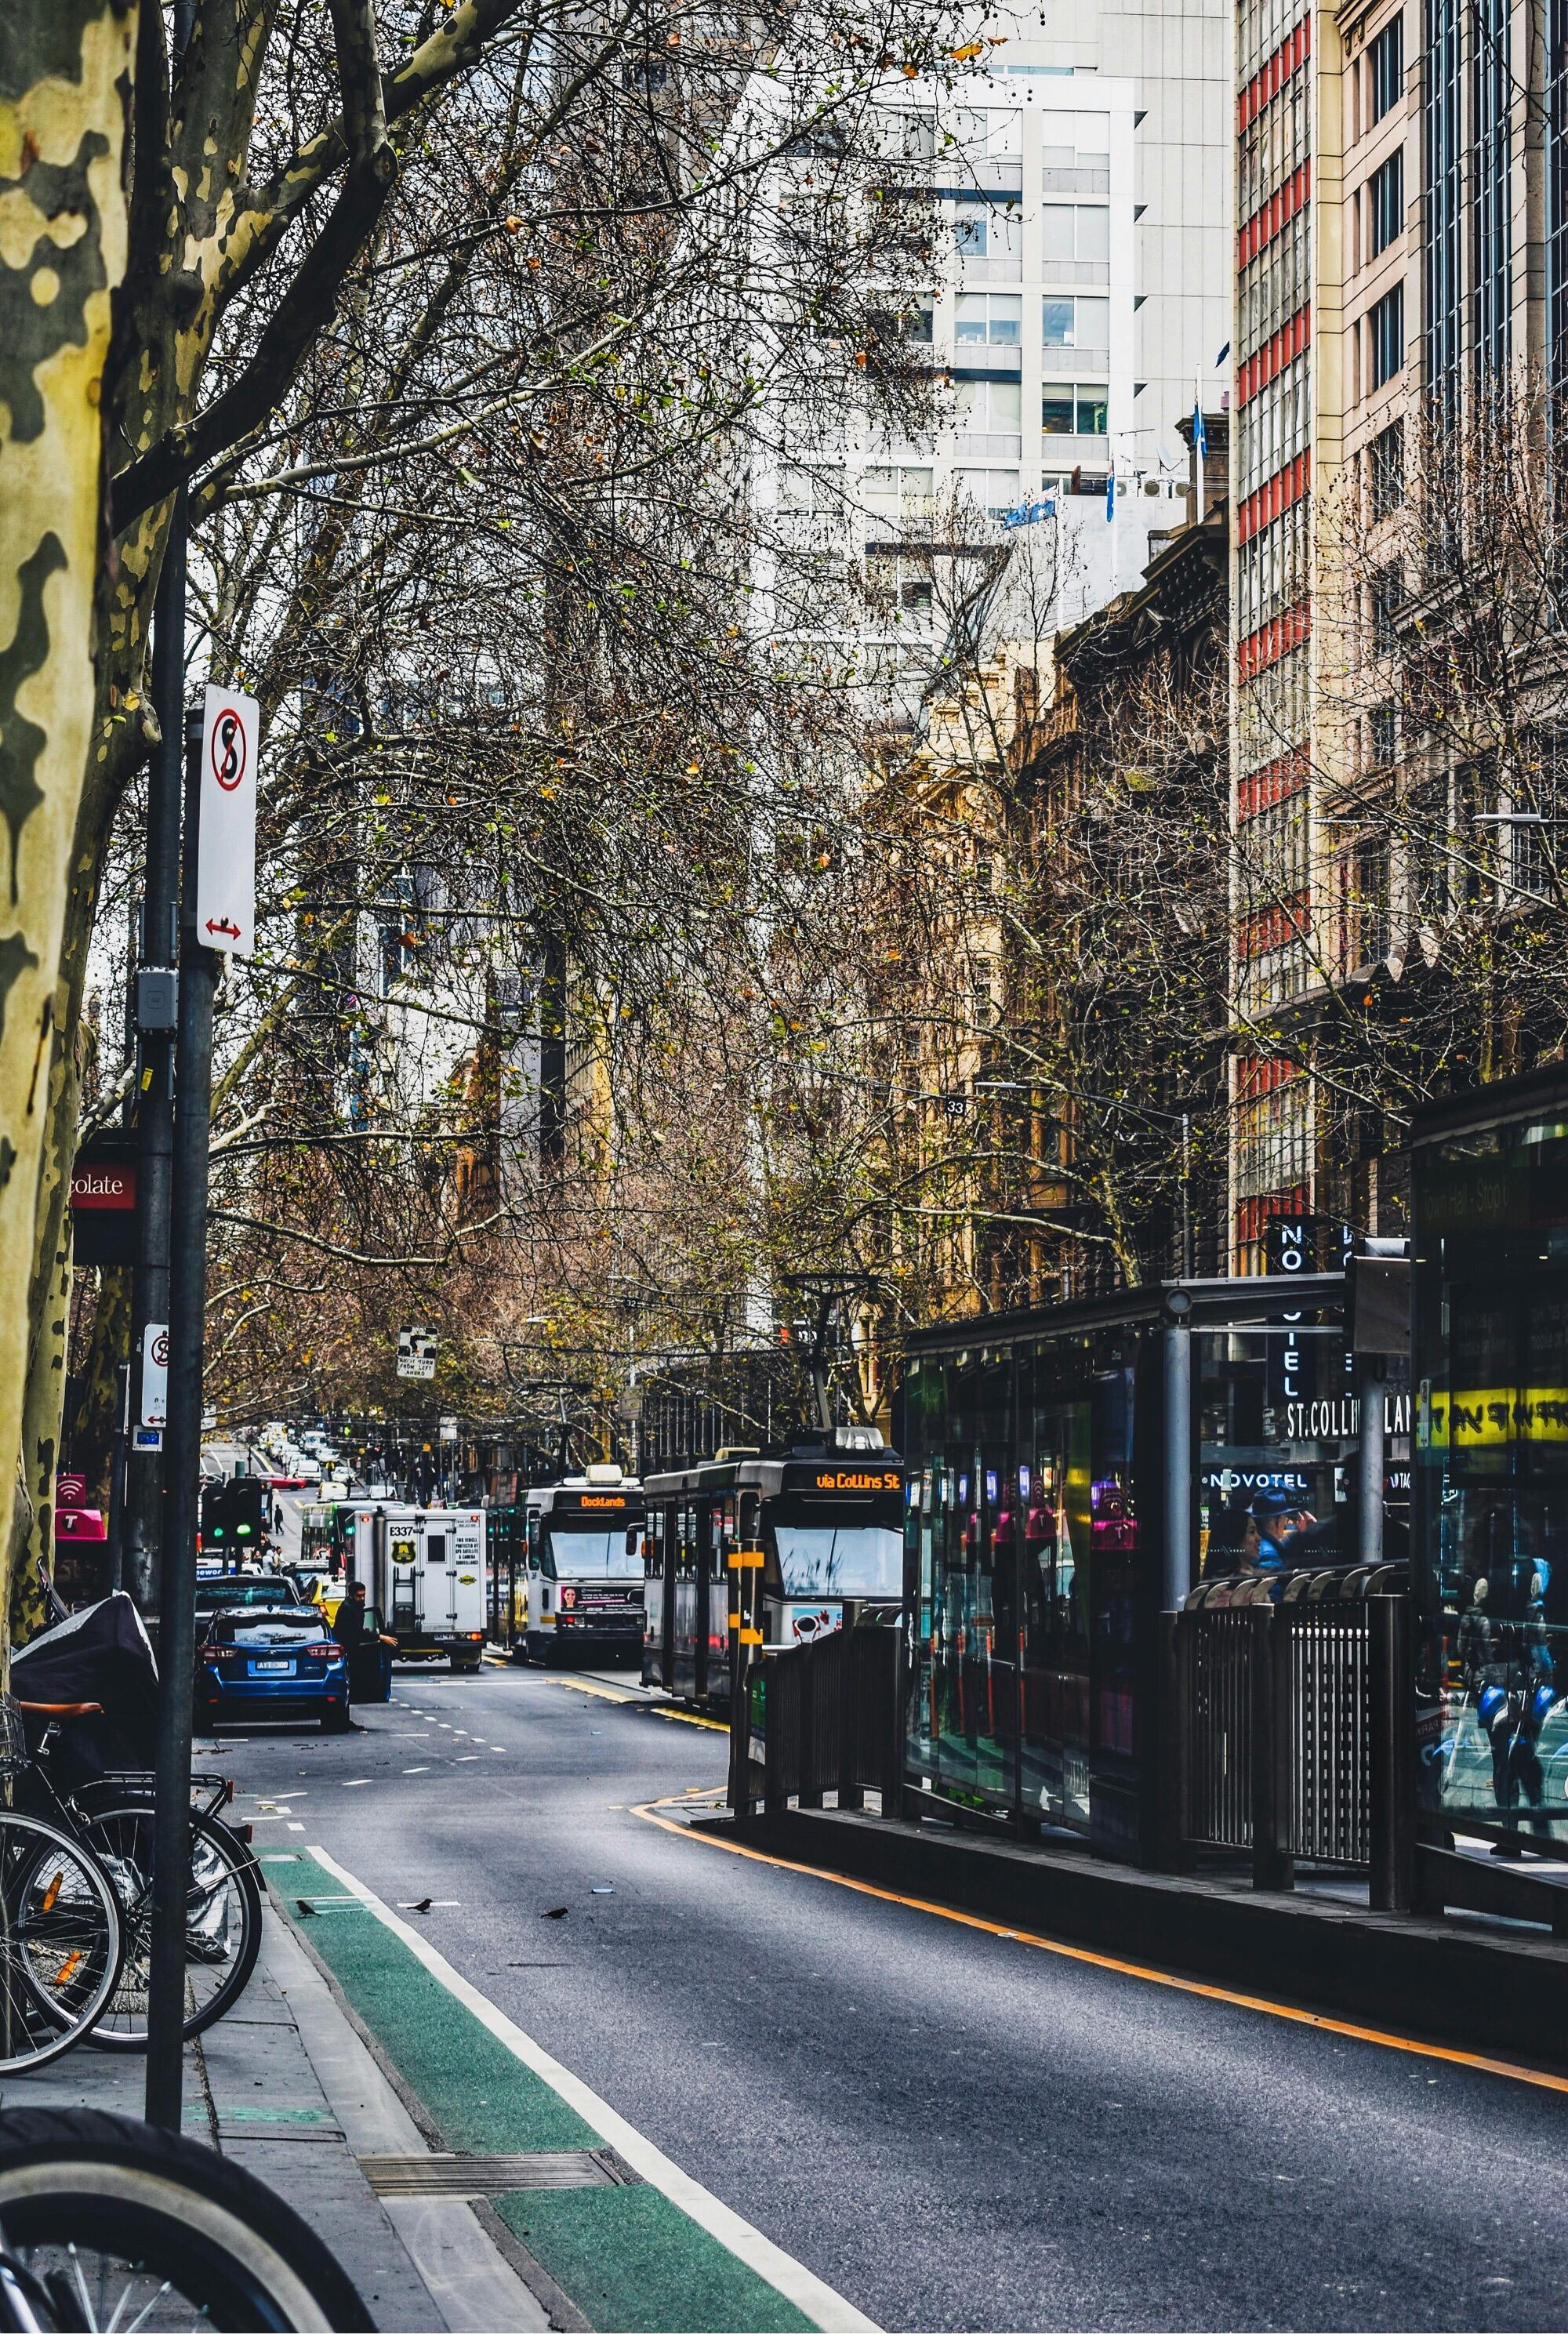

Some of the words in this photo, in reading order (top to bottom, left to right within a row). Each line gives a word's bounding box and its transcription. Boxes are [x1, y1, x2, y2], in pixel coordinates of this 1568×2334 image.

[947, 1101, 964, 1113] 33
[1282, 1225, 1301, 1396] NOTEL
[816, 1474, 835, 1488] via
[837, 1473, 882, 1489] Collins
[884, 1473, 900, 1489] St
[1210, 1473, 1307, 1488] NOVOTEL
[581, 1496, 626, 1507] Docklands
[390, 1526, 413, 1537] E337
